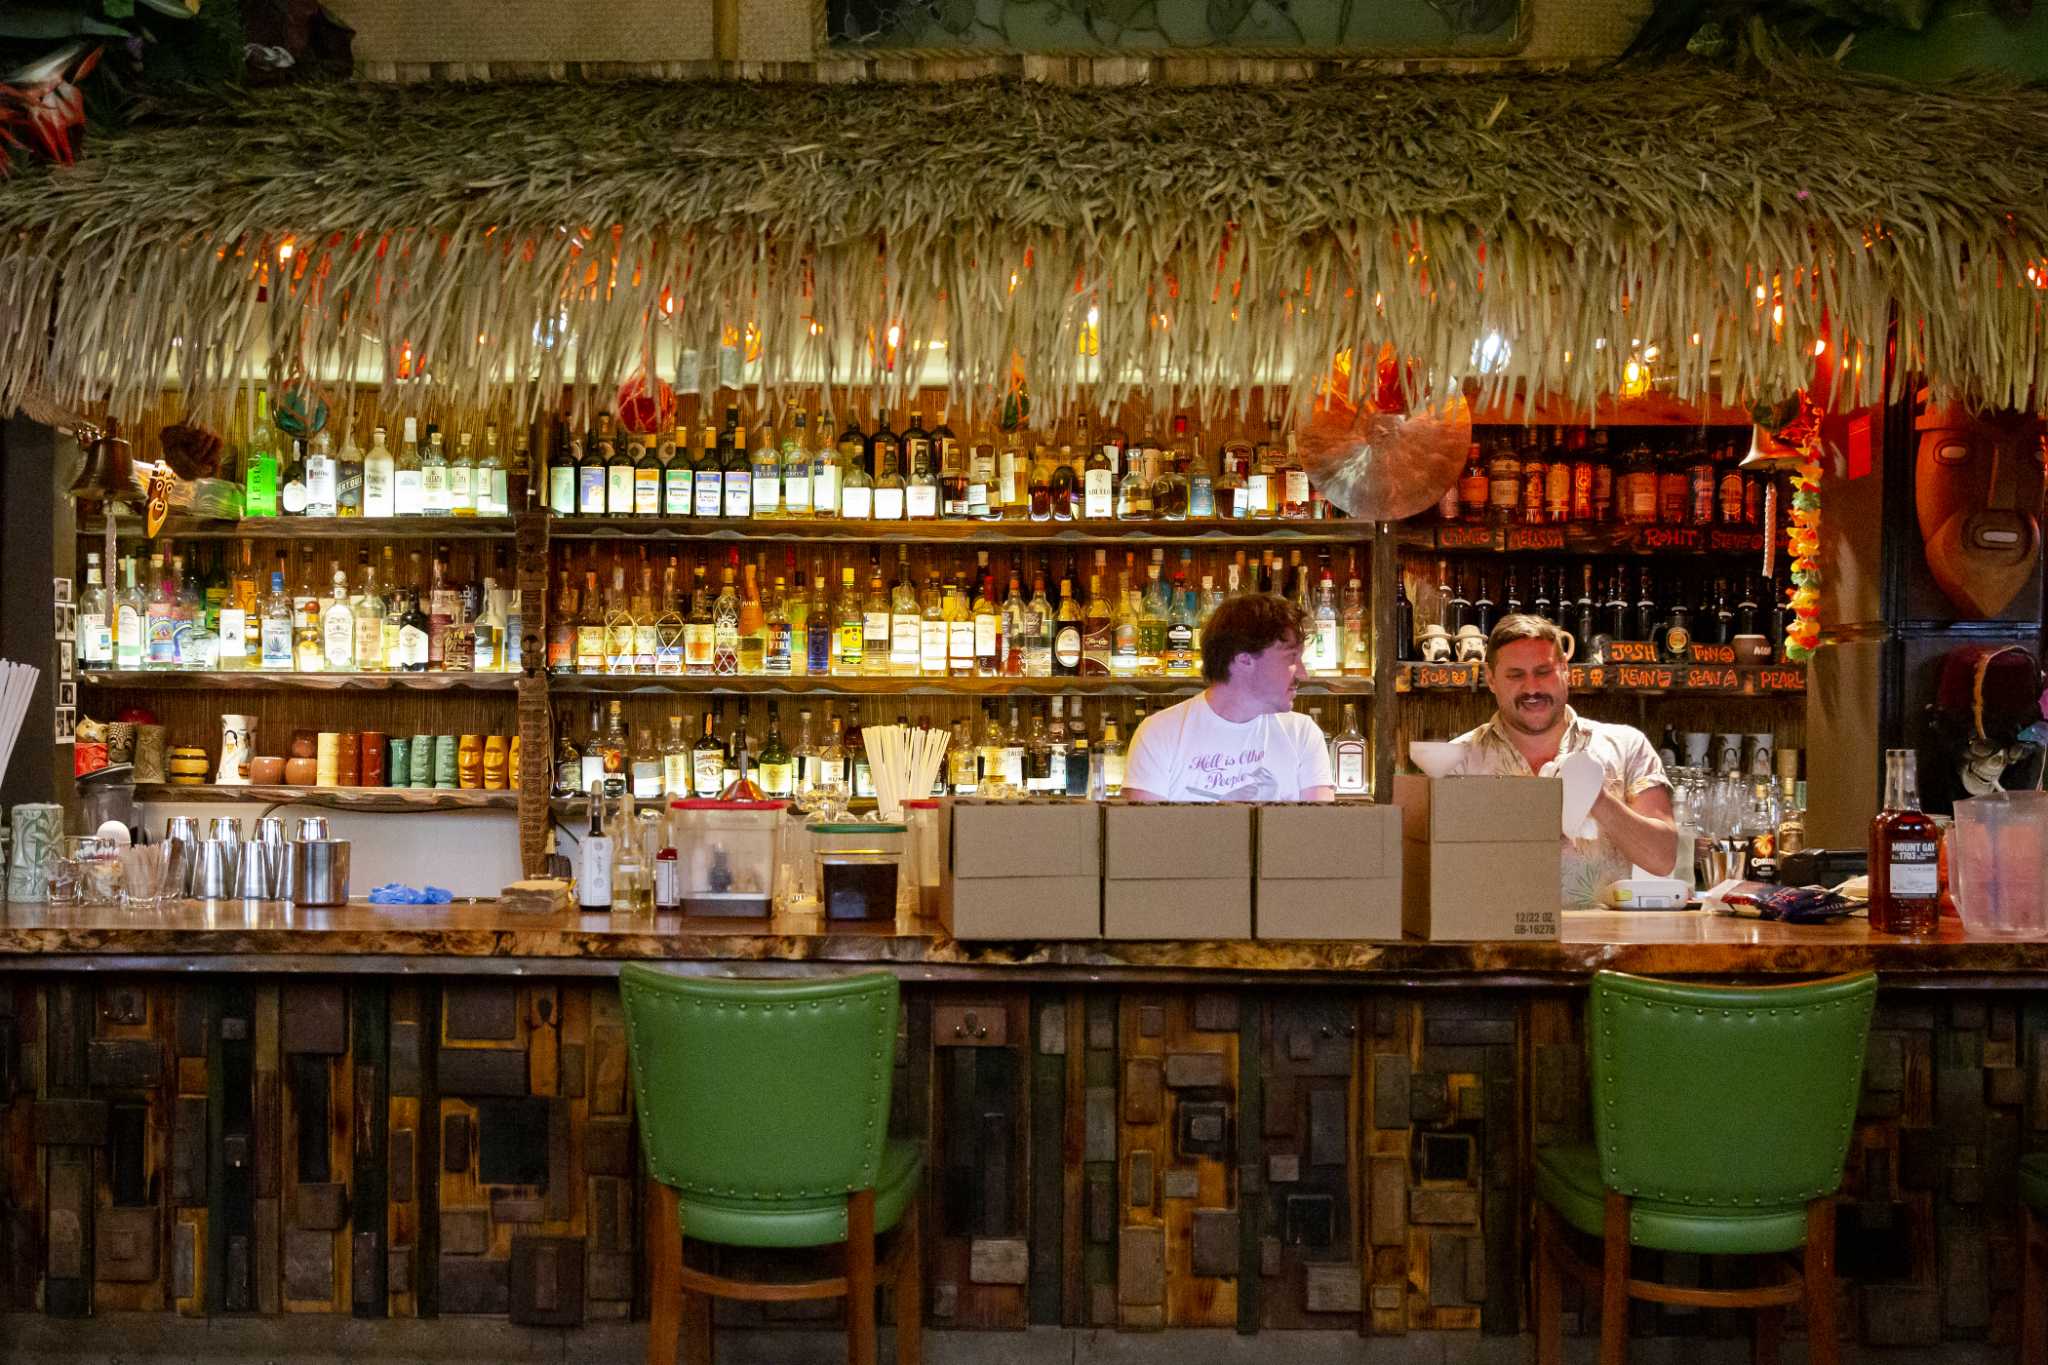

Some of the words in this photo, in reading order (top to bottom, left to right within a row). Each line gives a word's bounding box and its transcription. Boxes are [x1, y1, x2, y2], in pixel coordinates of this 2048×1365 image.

[1611, 644, 1657, 662] JOSH
[1761, 672, 1805, 689] PEARL
[1225, 755, 1235, 766] is
[1892, 843, 1920, 852] MOUNT
[1922, 843, 1935, 852] GAY
